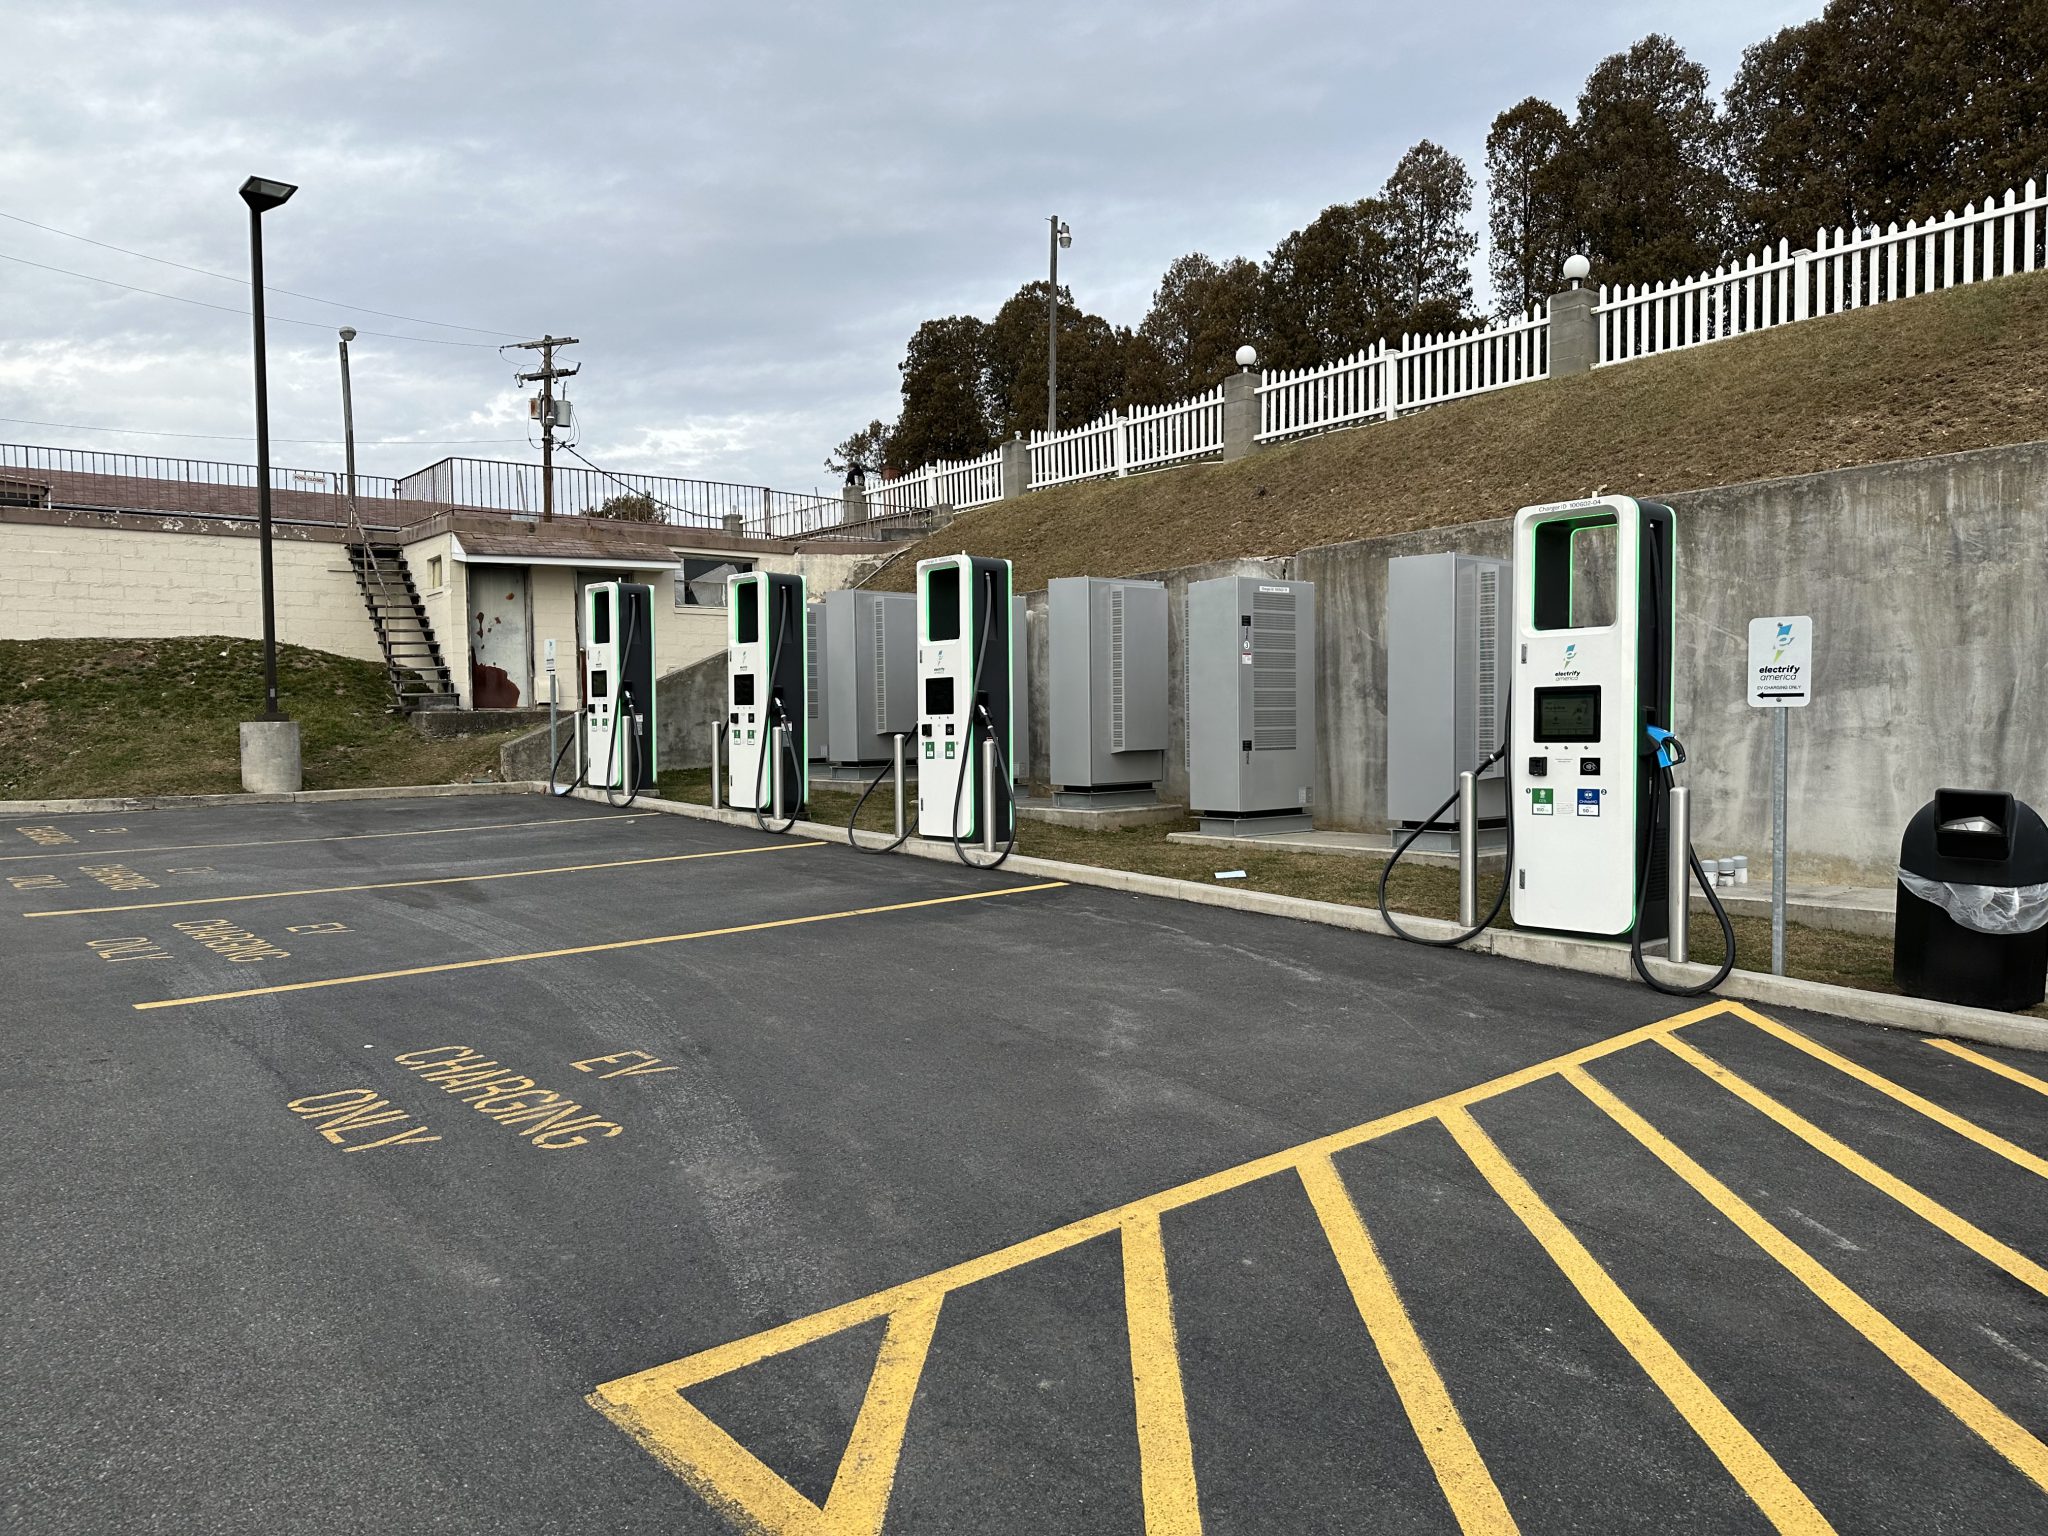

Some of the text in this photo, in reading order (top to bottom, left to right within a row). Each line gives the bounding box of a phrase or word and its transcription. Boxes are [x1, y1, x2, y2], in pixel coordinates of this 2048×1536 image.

[1759, 665, 1800, 674] electrify
[172, 918, 291, 962] CHARGING
[286, 922, 355, 935] EV
[86, 936, 174, 962] ONLY
[569, 1050, 679, 1079] EV
[394, 1045, 624, 1150] CHARGING
[287, 1088, 442, 1153] ONLY
